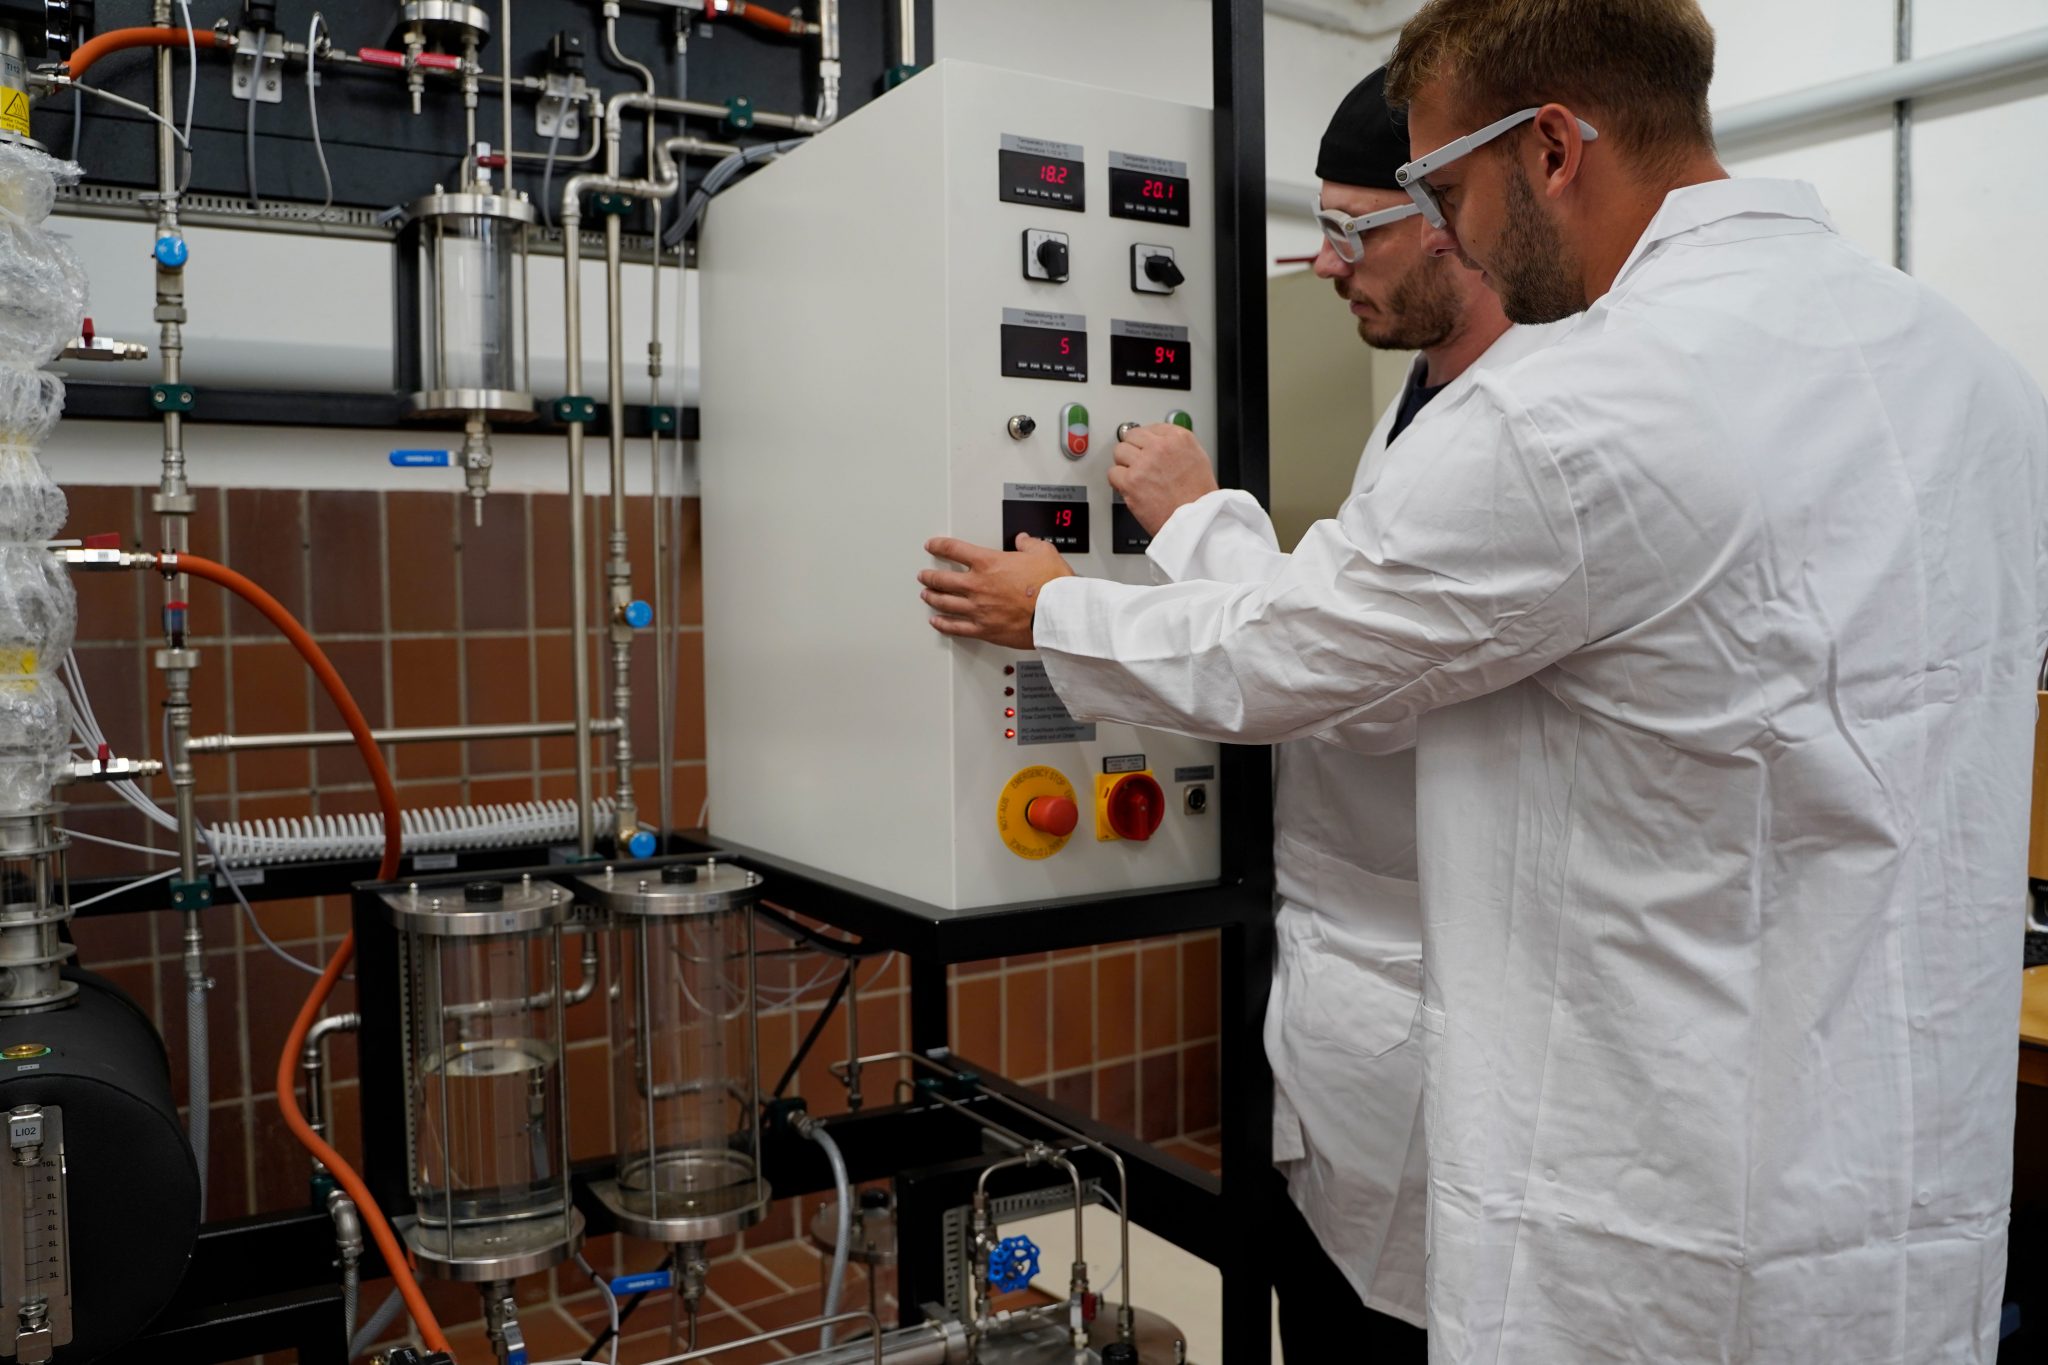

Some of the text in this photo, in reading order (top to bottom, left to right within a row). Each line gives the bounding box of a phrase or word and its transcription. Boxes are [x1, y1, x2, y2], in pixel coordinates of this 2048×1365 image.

[1040, 165, 1067, 184] 18.2
[1142, 180, 1174, 199] 20.1
[1061, 337, 1070, 355] 5
[1155, 346, 1175, 363] 94
[1056, 509, 1072, 527] 19
[1049, 770, 1066, 786] STOP
[15, 1127, 37, 1137] LI02
